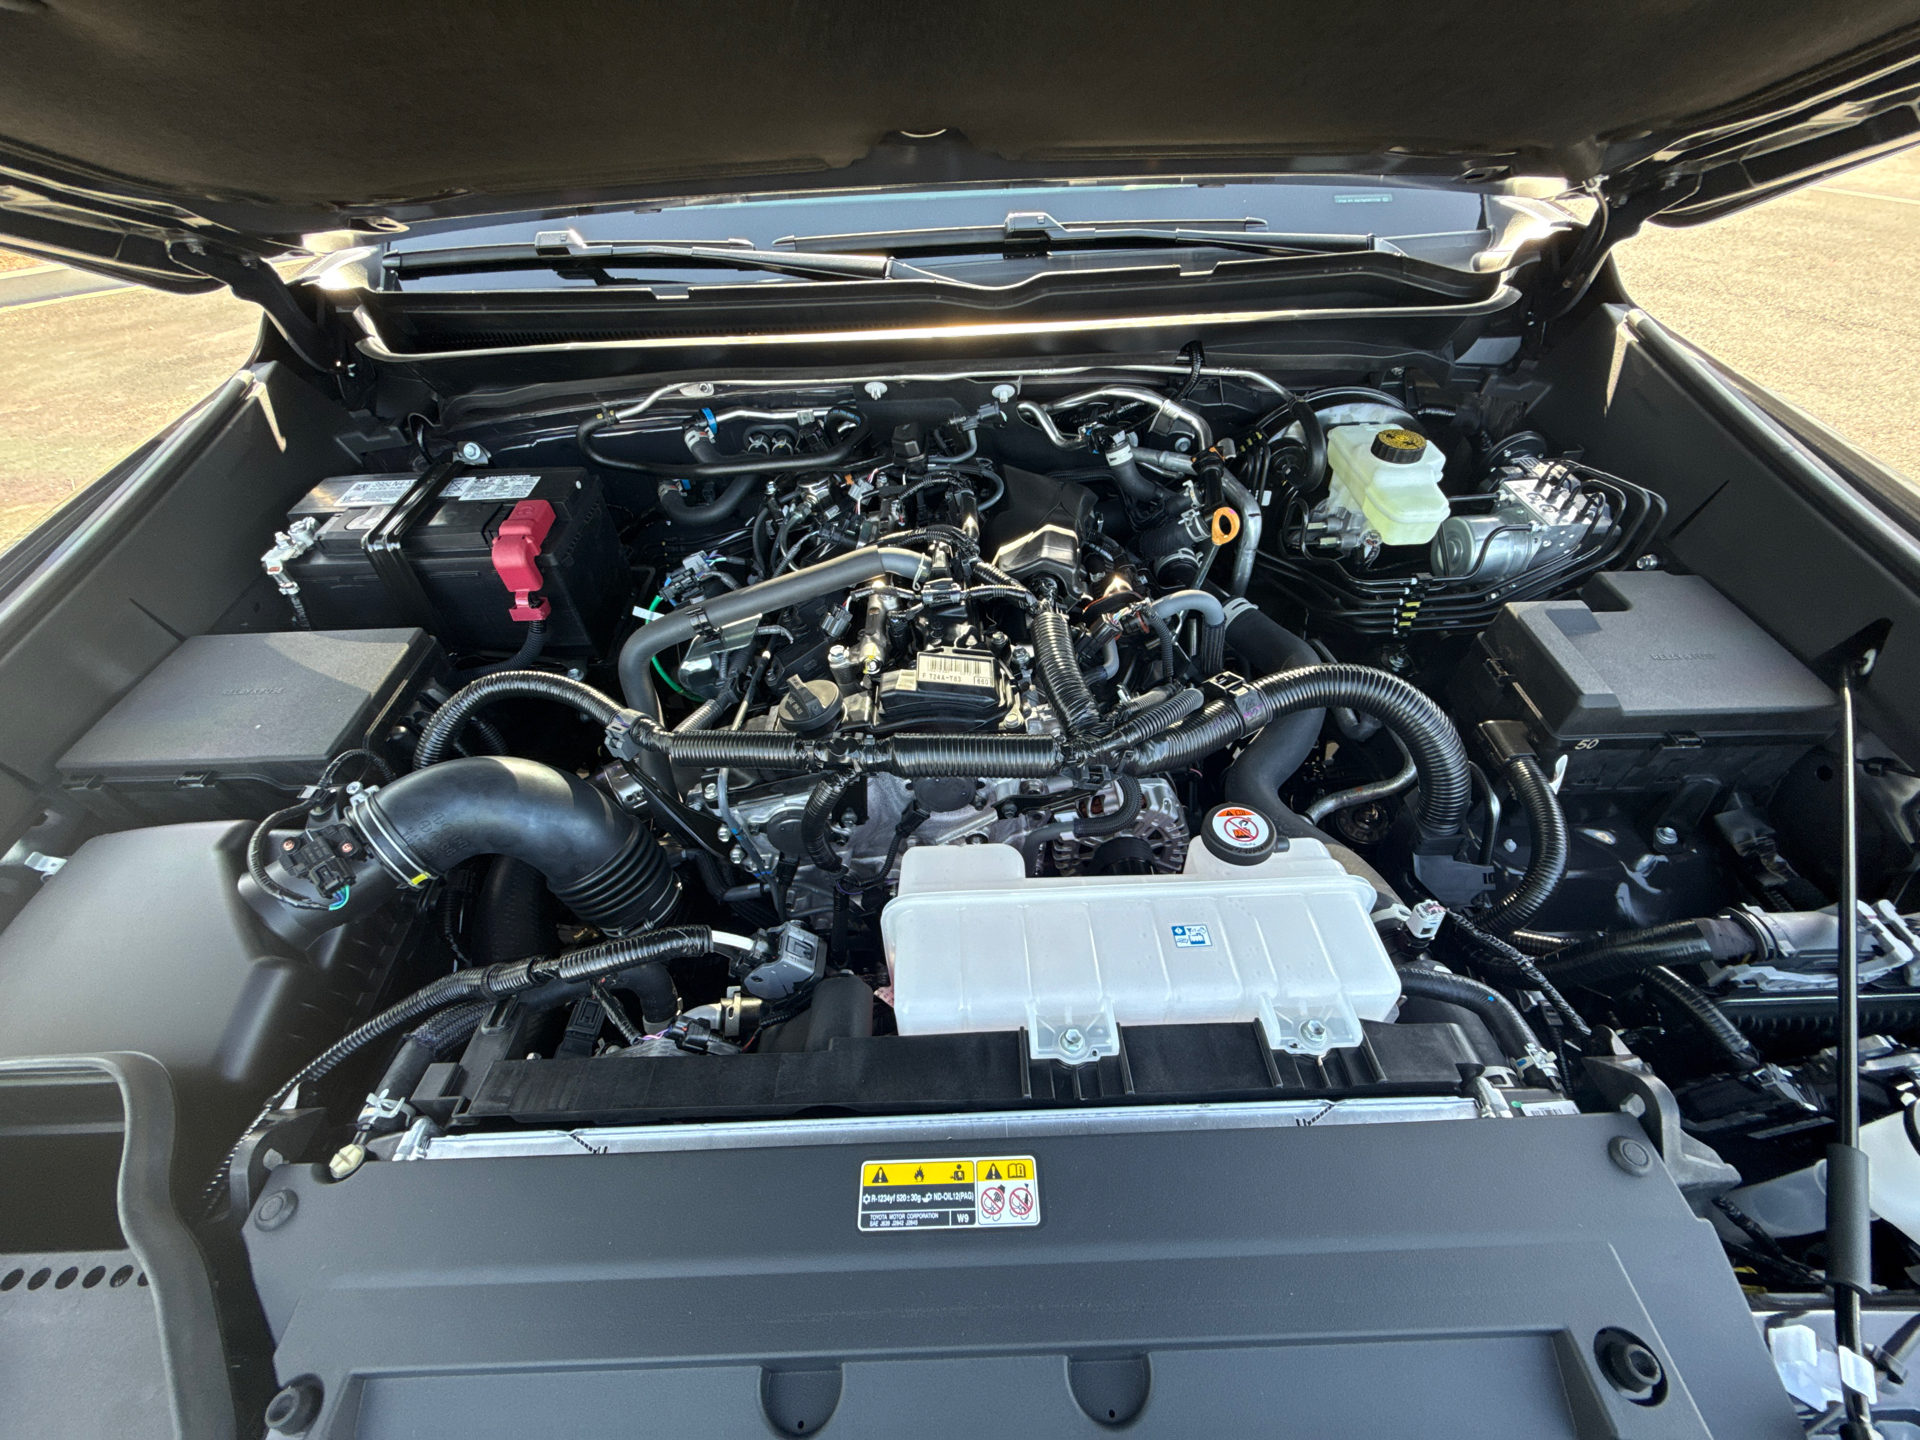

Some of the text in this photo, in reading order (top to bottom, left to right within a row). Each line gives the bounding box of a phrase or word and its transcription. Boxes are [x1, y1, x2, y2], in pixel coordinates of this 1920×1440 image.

[1574, 738, 1600, 750] 50
[871, 1193, 896, 1204] R-1234yf
[933, 1191, 975, 1202] ND-OIL12(PAG)
[906, 1212, 939, 1220] CORPORATION
[956, 1213, 970, 1223] W9
